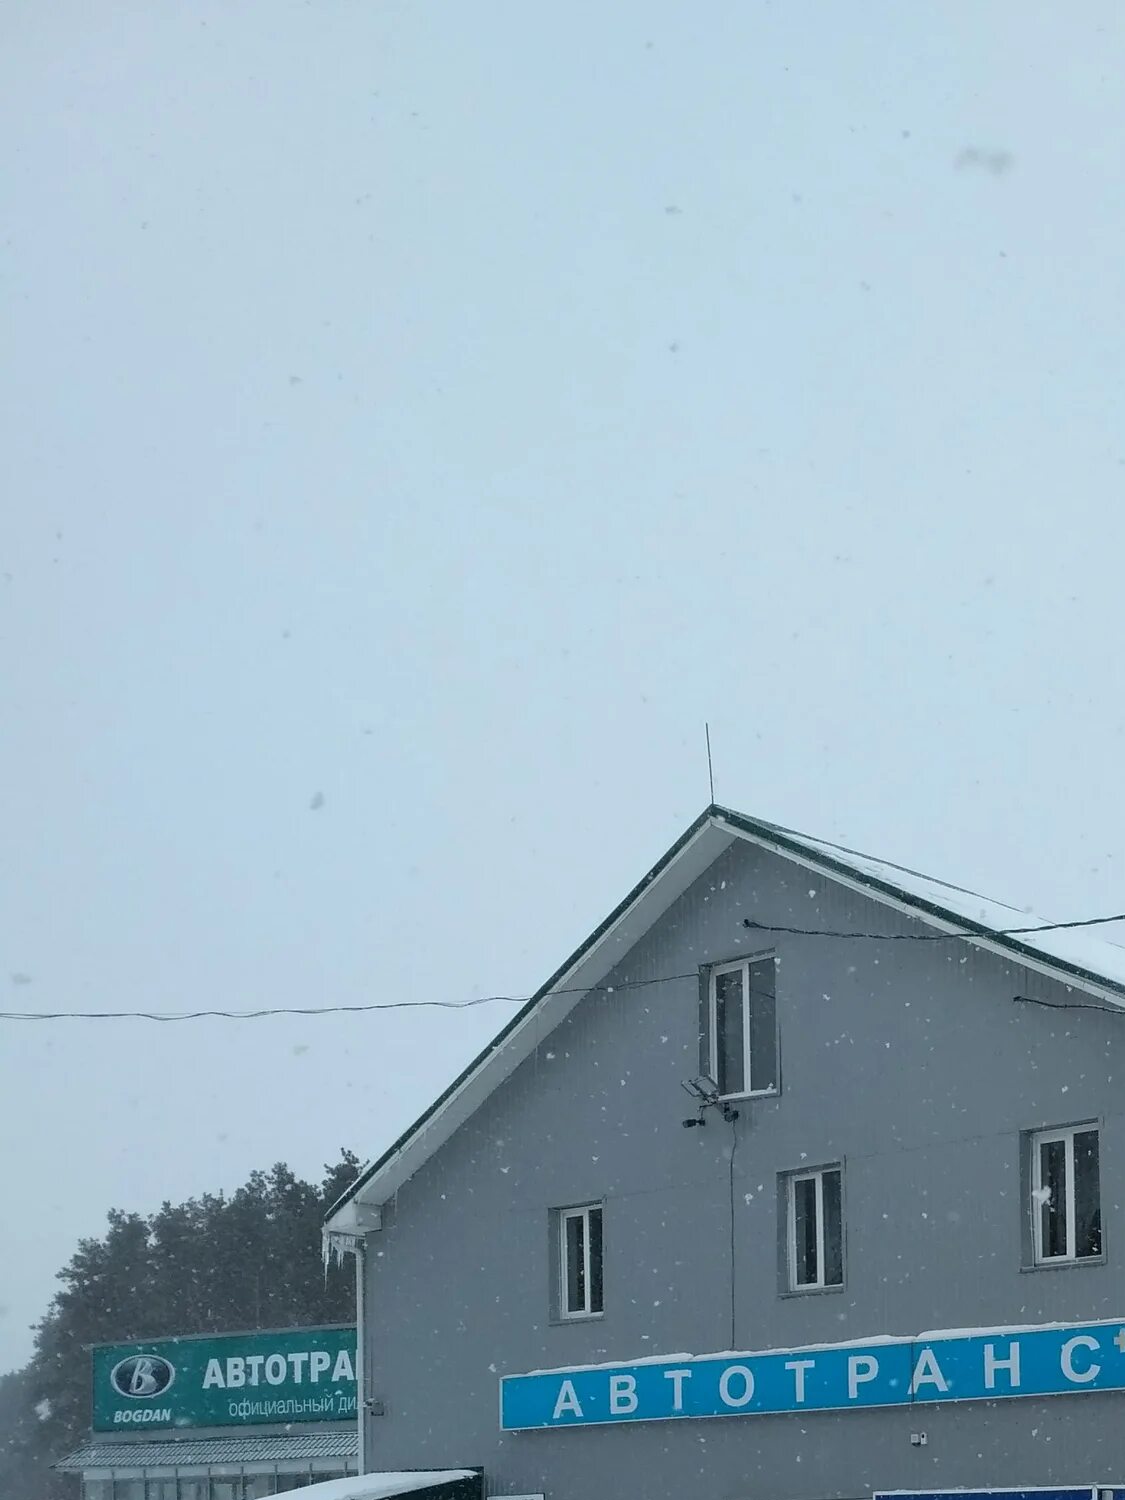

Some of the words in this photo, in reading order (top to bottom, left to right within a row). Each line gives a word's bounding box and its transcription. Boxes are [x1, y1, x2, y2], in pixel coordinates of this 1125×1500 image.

[202, 1349, 358, 1389] АВТОТРА
[113, 1408, 172, 1423] BOGDAN
[229, 1393, 334, 1420] официальный
[338, 1397, 358, 1414] ди
